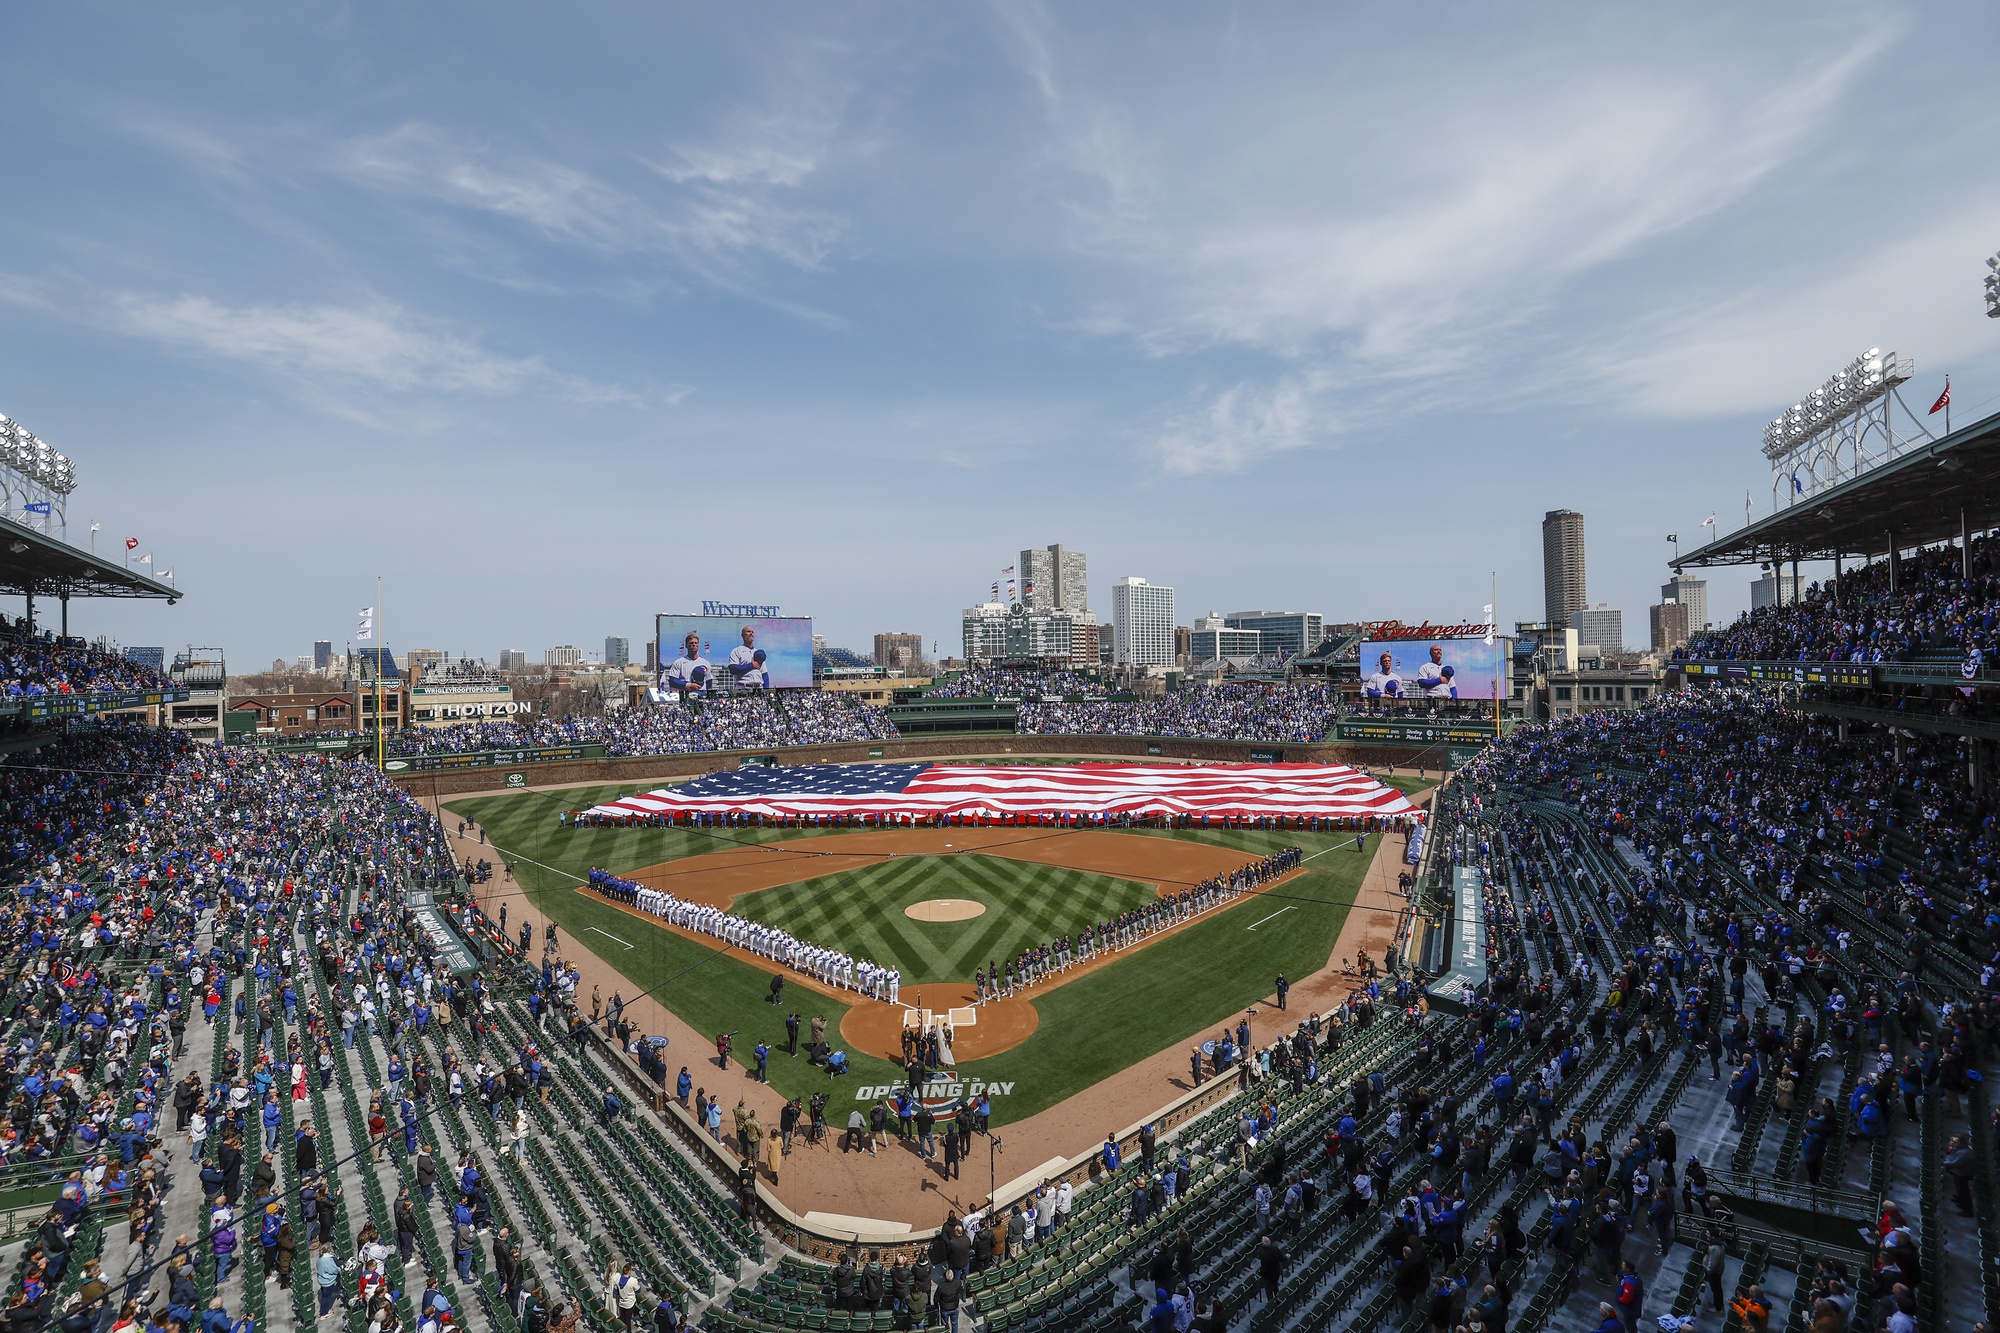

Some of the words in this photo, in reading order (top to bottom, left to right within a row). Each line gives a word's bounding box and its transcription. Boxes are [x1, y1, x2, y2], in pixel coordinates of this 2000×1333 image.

[1368, 619, 1498, 640] Budweiser
[448, 702, 531, 716] HORIZON
[855, 1083, 964, 1100] OPEING
[970, 1082, 1015, 1097] DAY
[970, 1220, 980, 1232] 40
